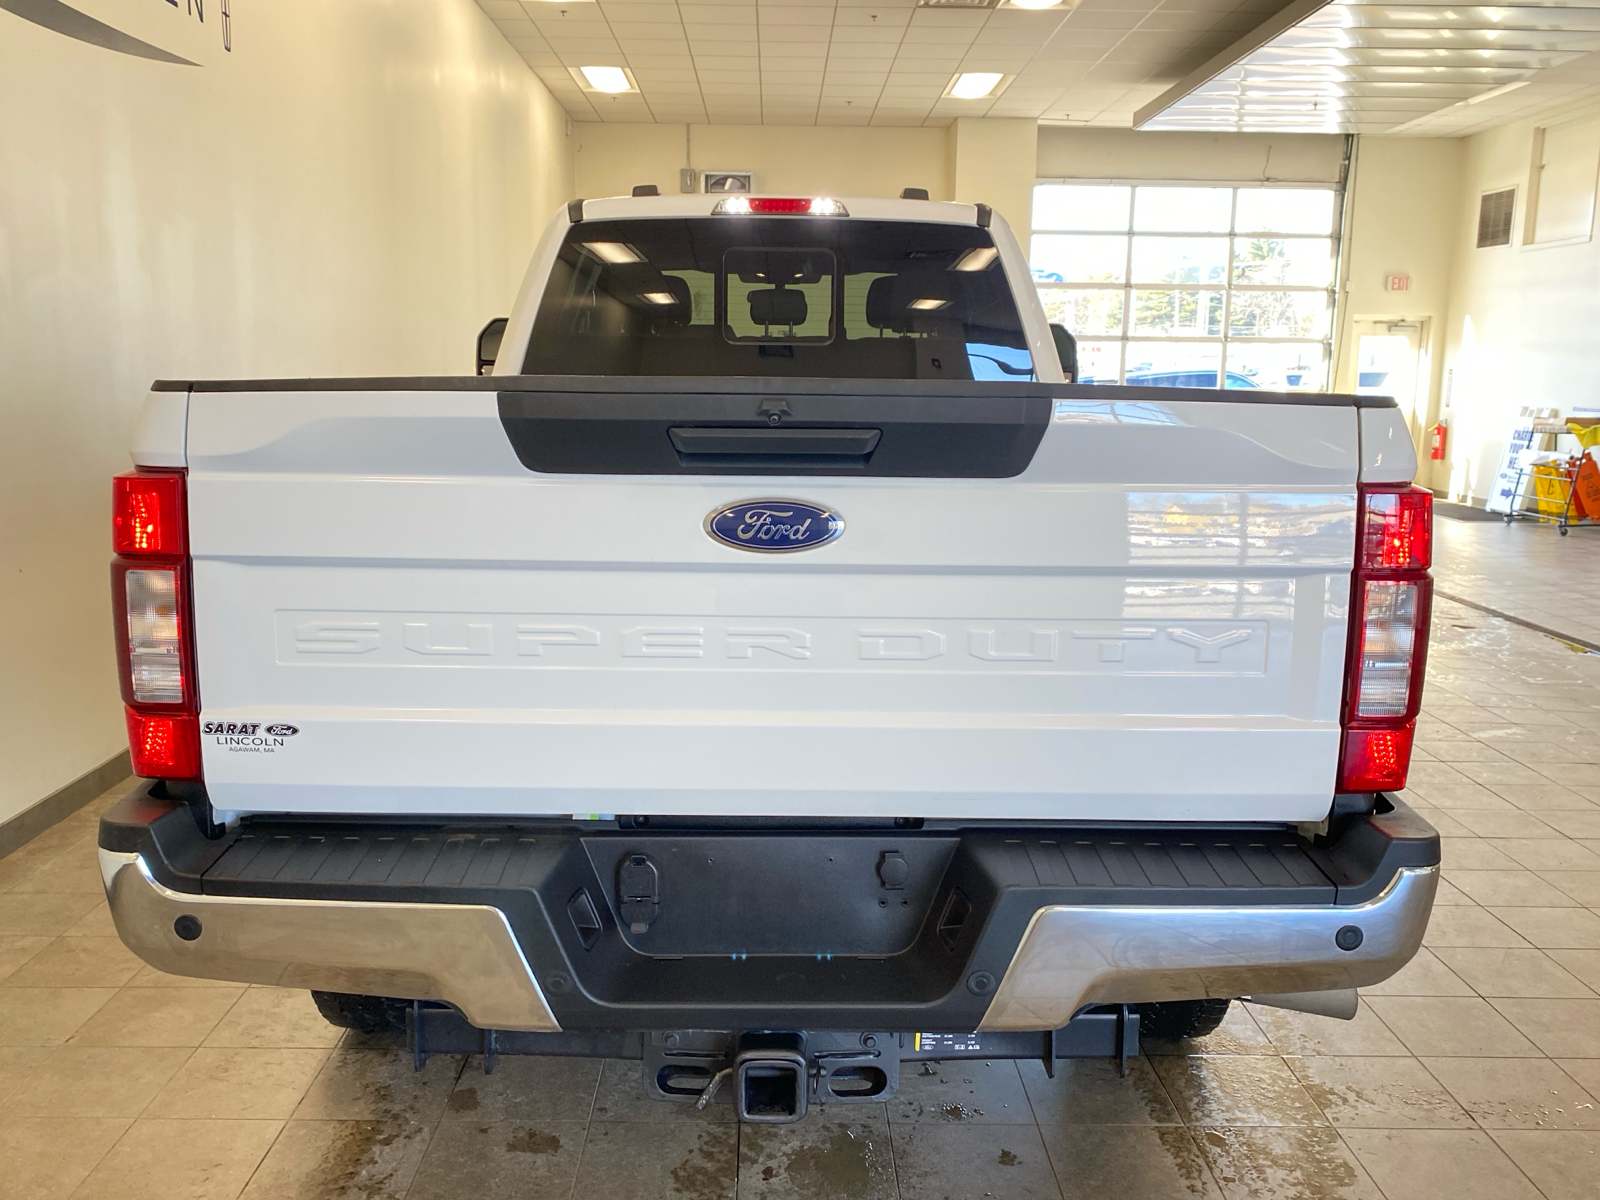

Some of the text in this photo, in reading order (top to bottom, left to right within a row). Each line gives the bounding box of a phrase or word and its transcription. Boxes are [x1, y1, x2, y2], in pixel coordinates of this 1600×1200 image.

[1391, 276, 1410, 291] EXIT
[736, 509, 811, 540] Ford
[295, 621, 1253, 664] SUPER DUTY
[203, 721, 261, 736] SARAT
[216, 736, 284, 746] LINCOLN
